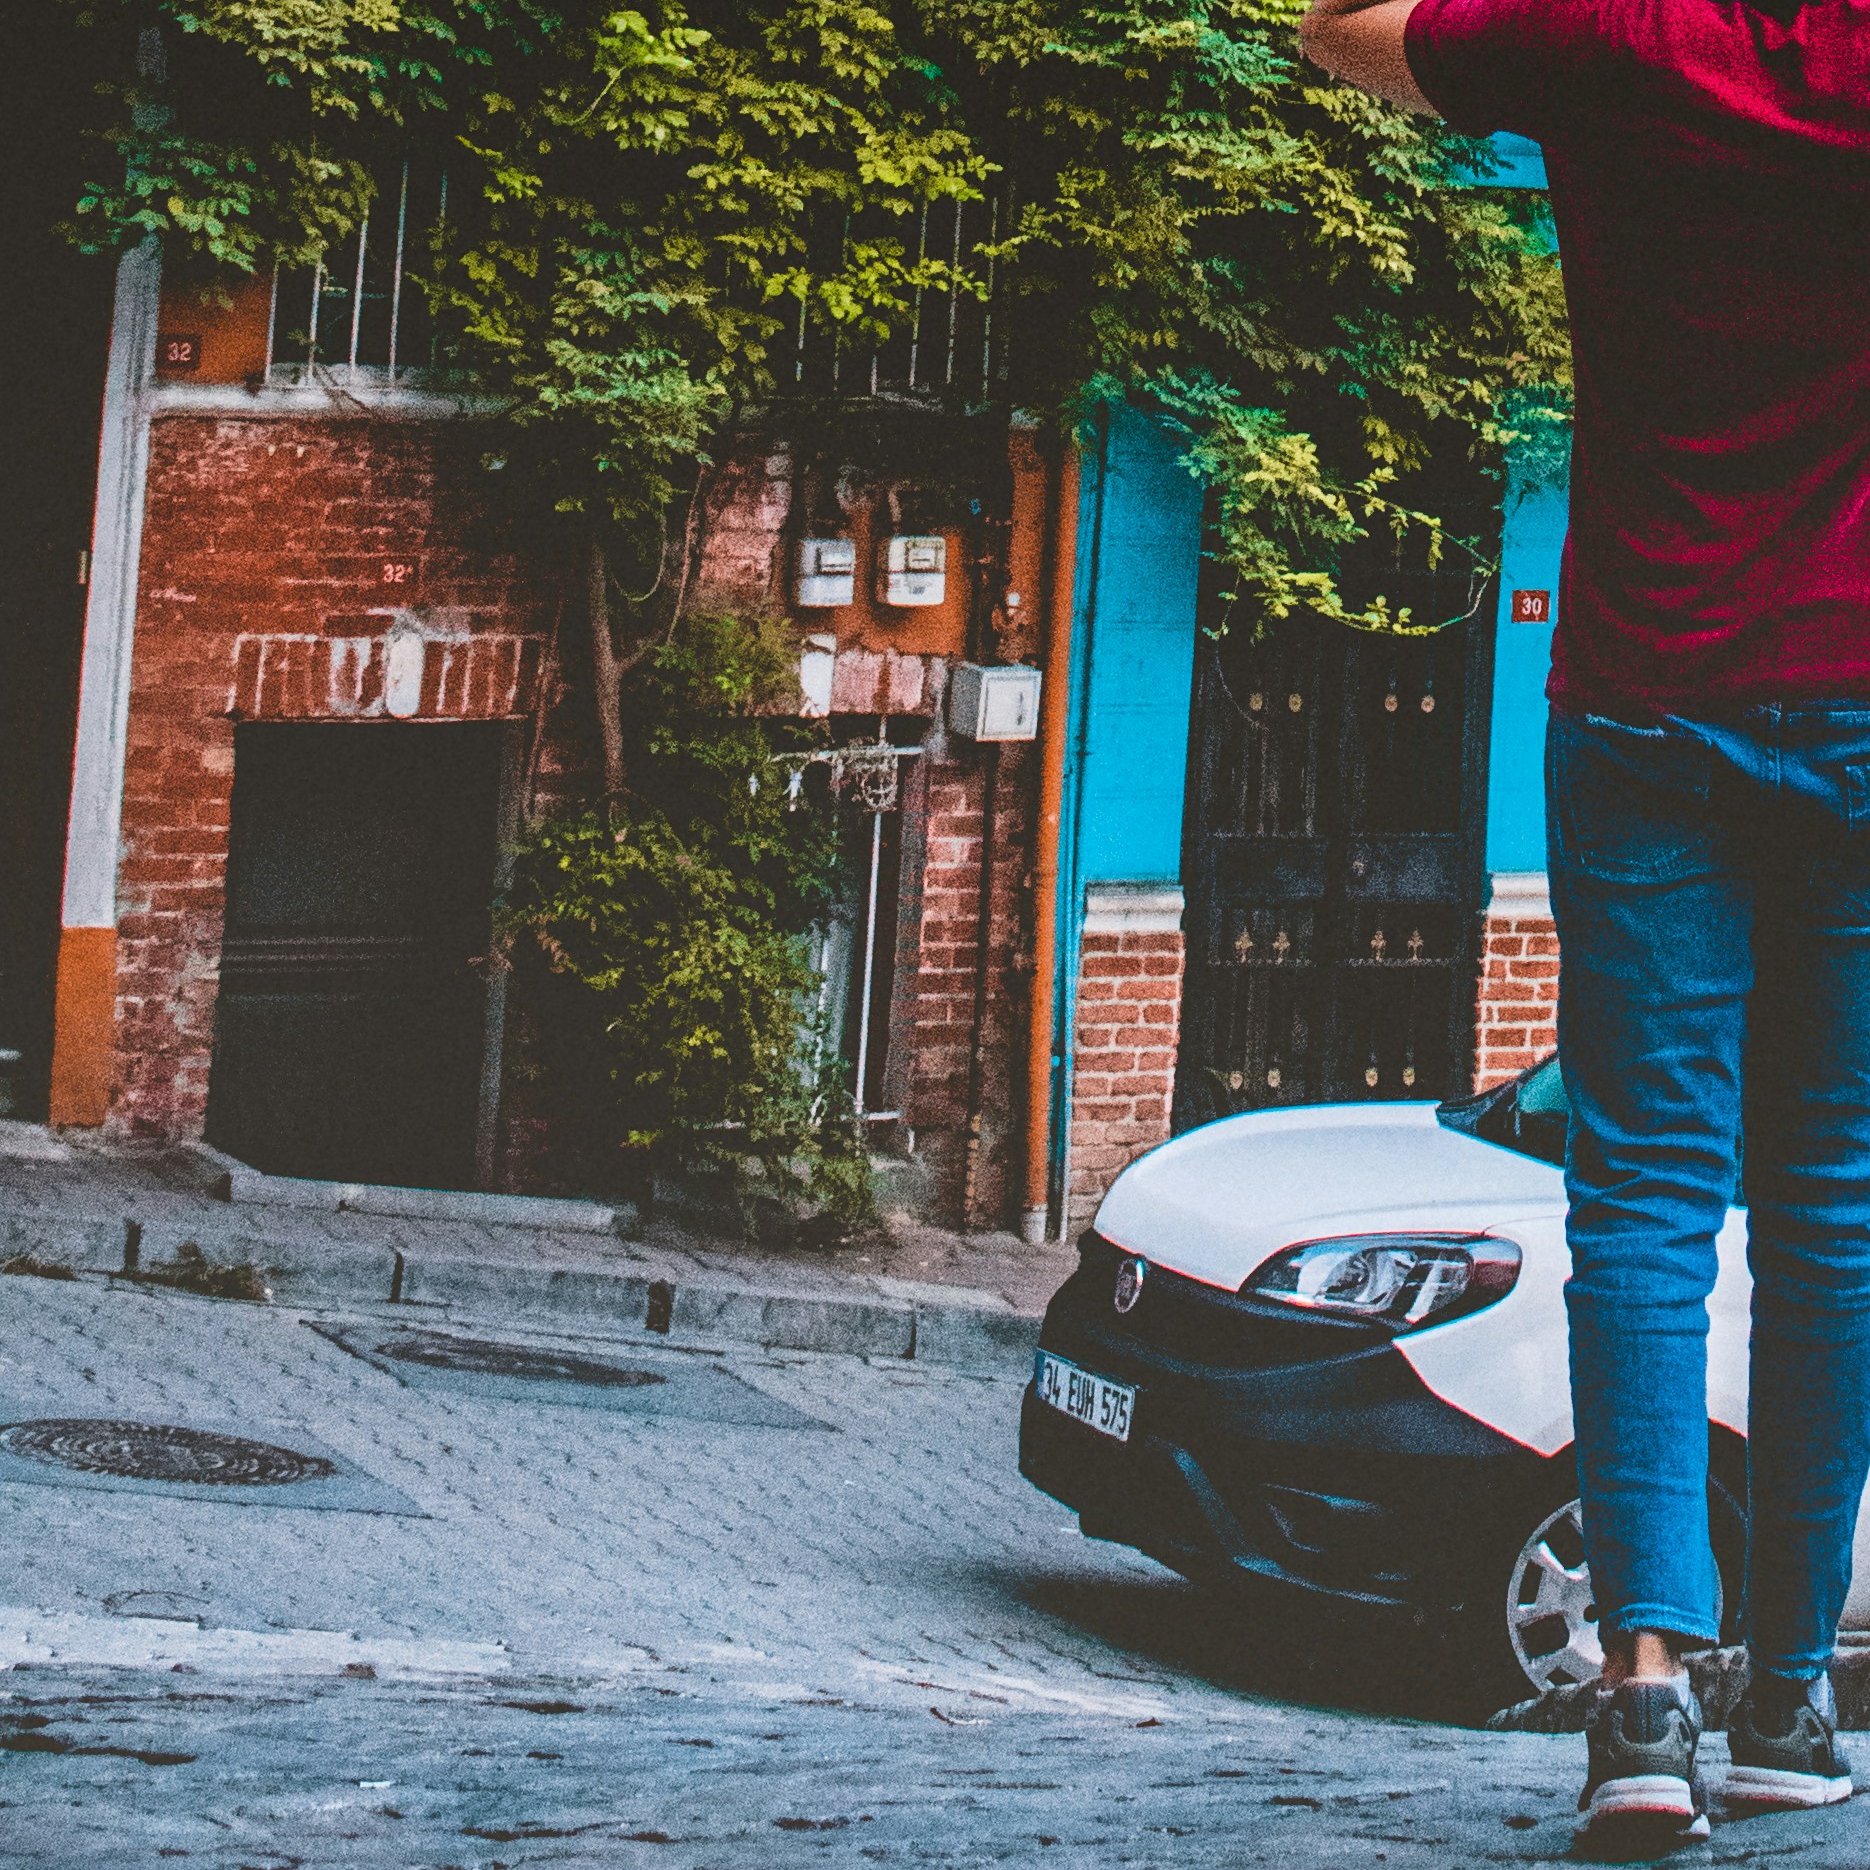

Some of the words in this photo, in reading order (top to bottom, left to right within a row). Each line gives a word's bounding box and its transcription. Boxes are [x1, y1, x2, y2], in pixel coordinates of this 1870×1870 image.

[168, 341, 192, 361] 32
[1522, 596, 1543, 615] 30
[1044, 1361, 1061, 1406] 34
[1101, 1385, 1129, 1434] 575
